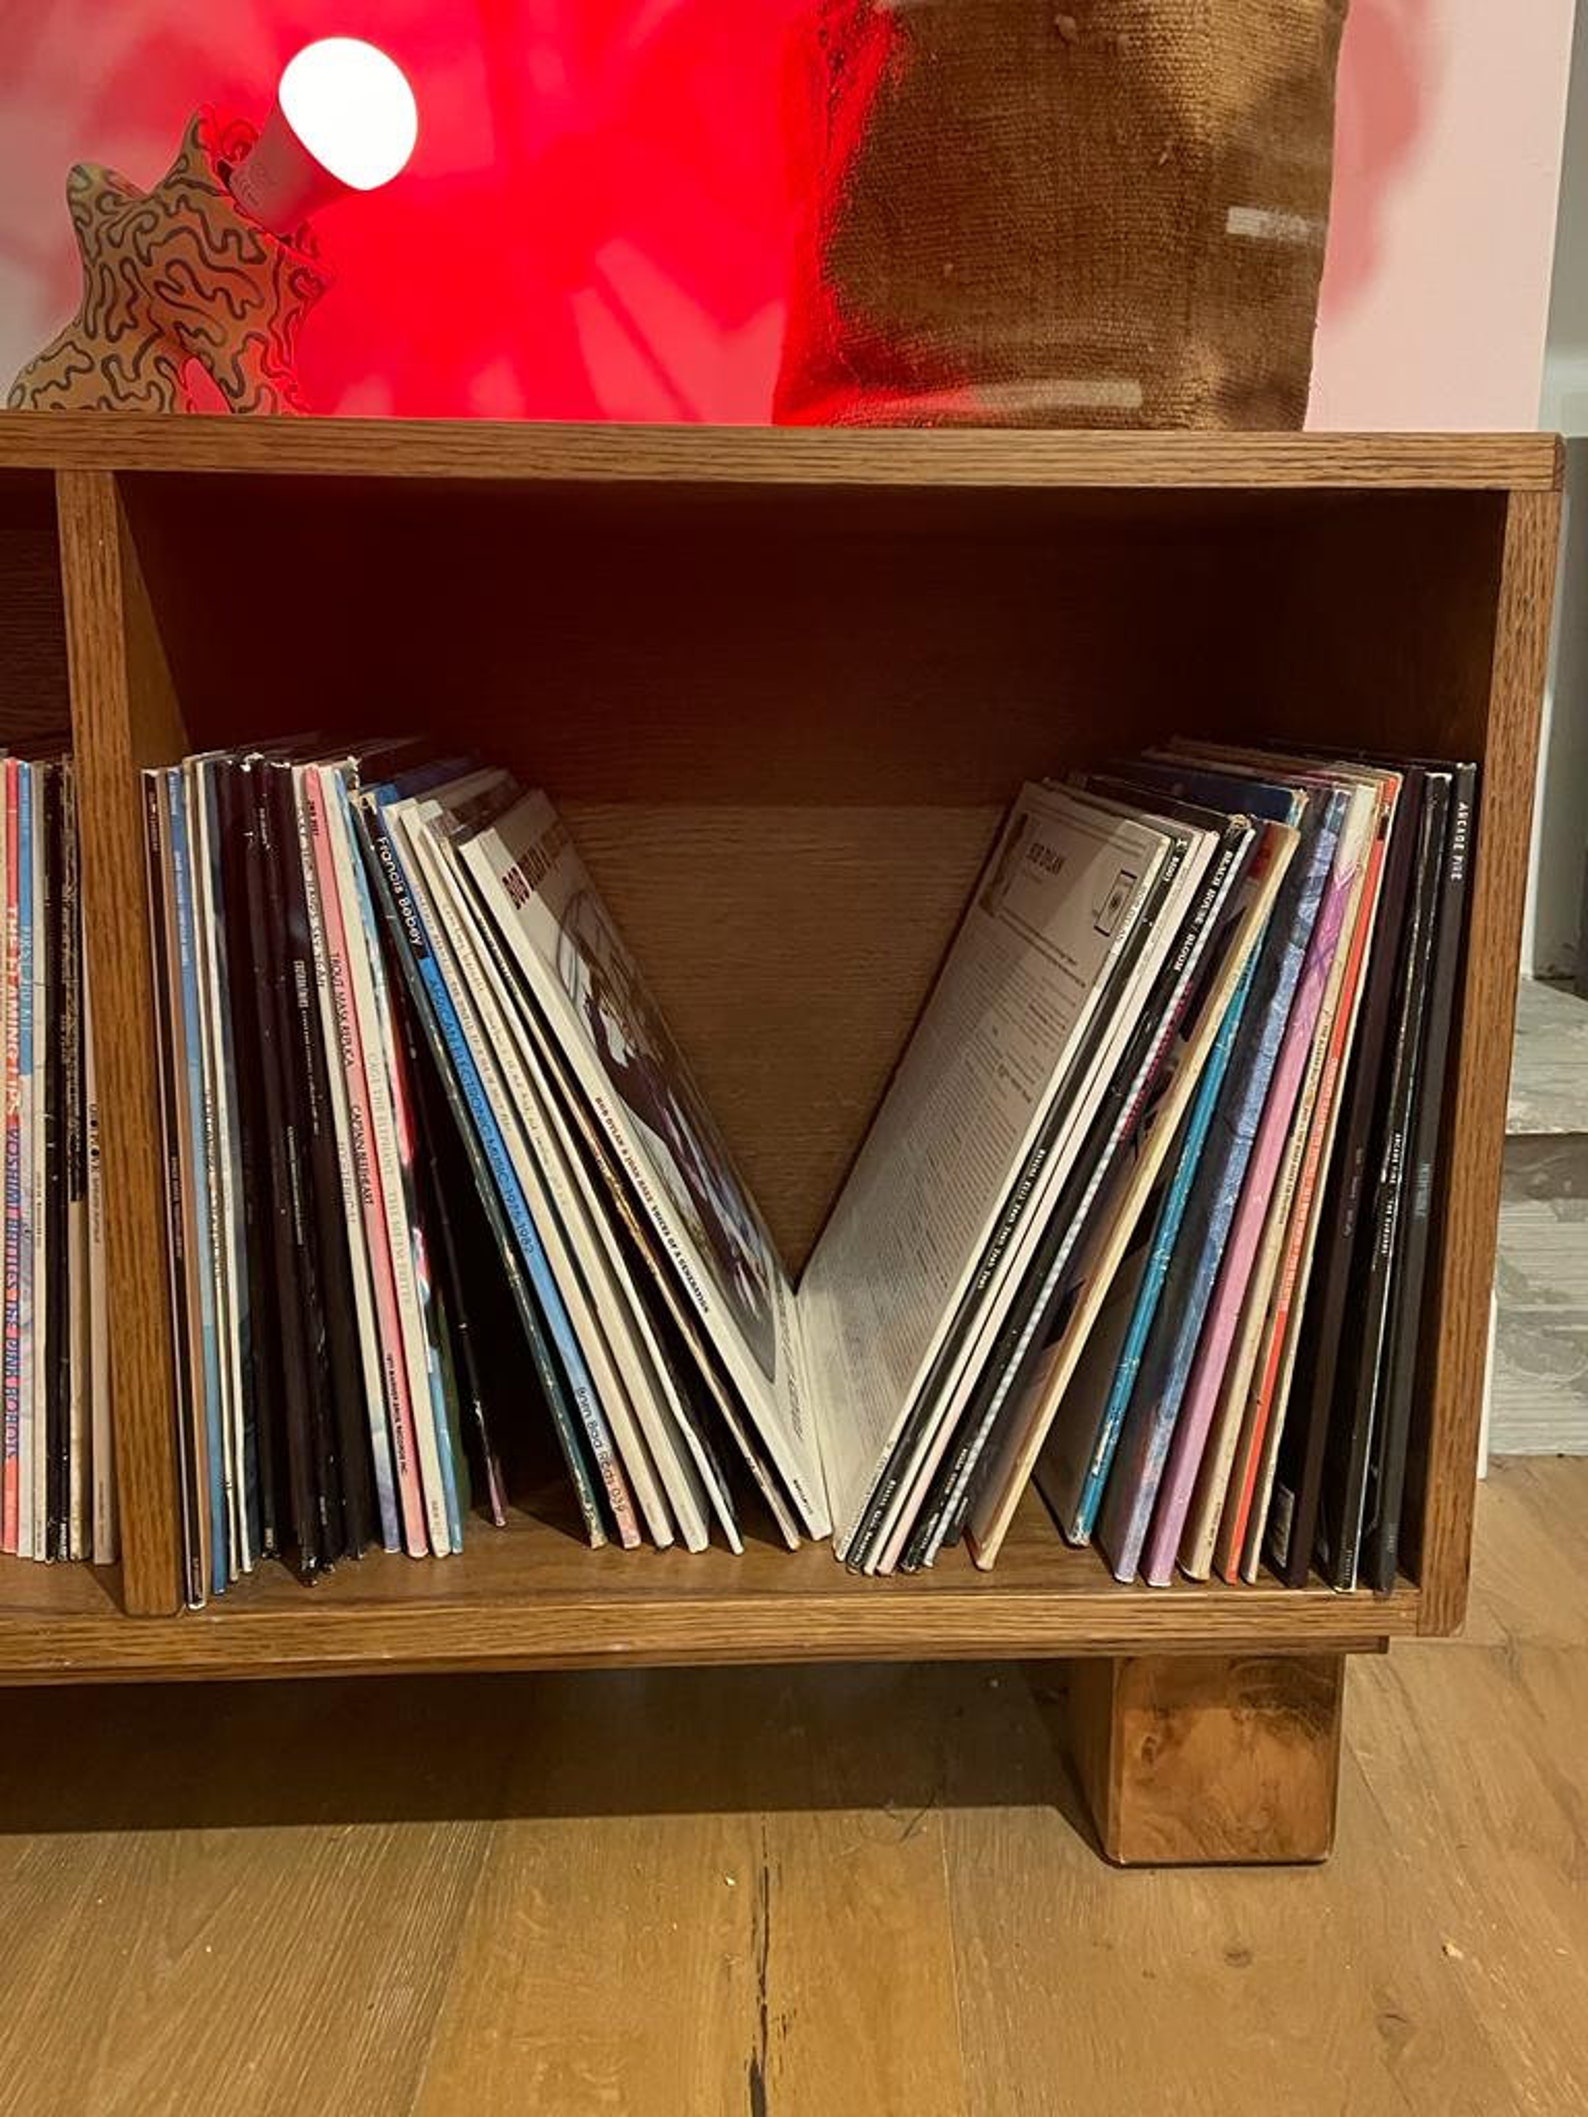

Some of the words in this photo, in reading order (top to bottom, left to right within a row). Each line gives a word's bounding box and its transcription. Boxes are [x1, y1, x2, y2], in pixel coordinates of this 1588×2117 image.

[1453, 801, 1469, 850] ARCADE
[377, 836, 405, 893] Francis
[398, 896, 424, 946] Bebey
[1213, 851, 1234, 886] BEACH
[1451, 855, 1464, 880] FIRE
[7, 906, 20, 947] THE
[1196, 888, 1217, 924] HOUSE
[1174, 933, 1197, 972] BLOOM
[6, 952, 19, 1062] FLAMING
[6, 1067, 20, 1115] LIPS
[595, 1097, 608, 1117] BOB
[605, 1118, 624, 1146] DYLAN
[5, 1127, 20, 1206] YOSHIMI
[577, 1387, 592, 1418] Born
[587, 1420, 602, 1448] Bad
